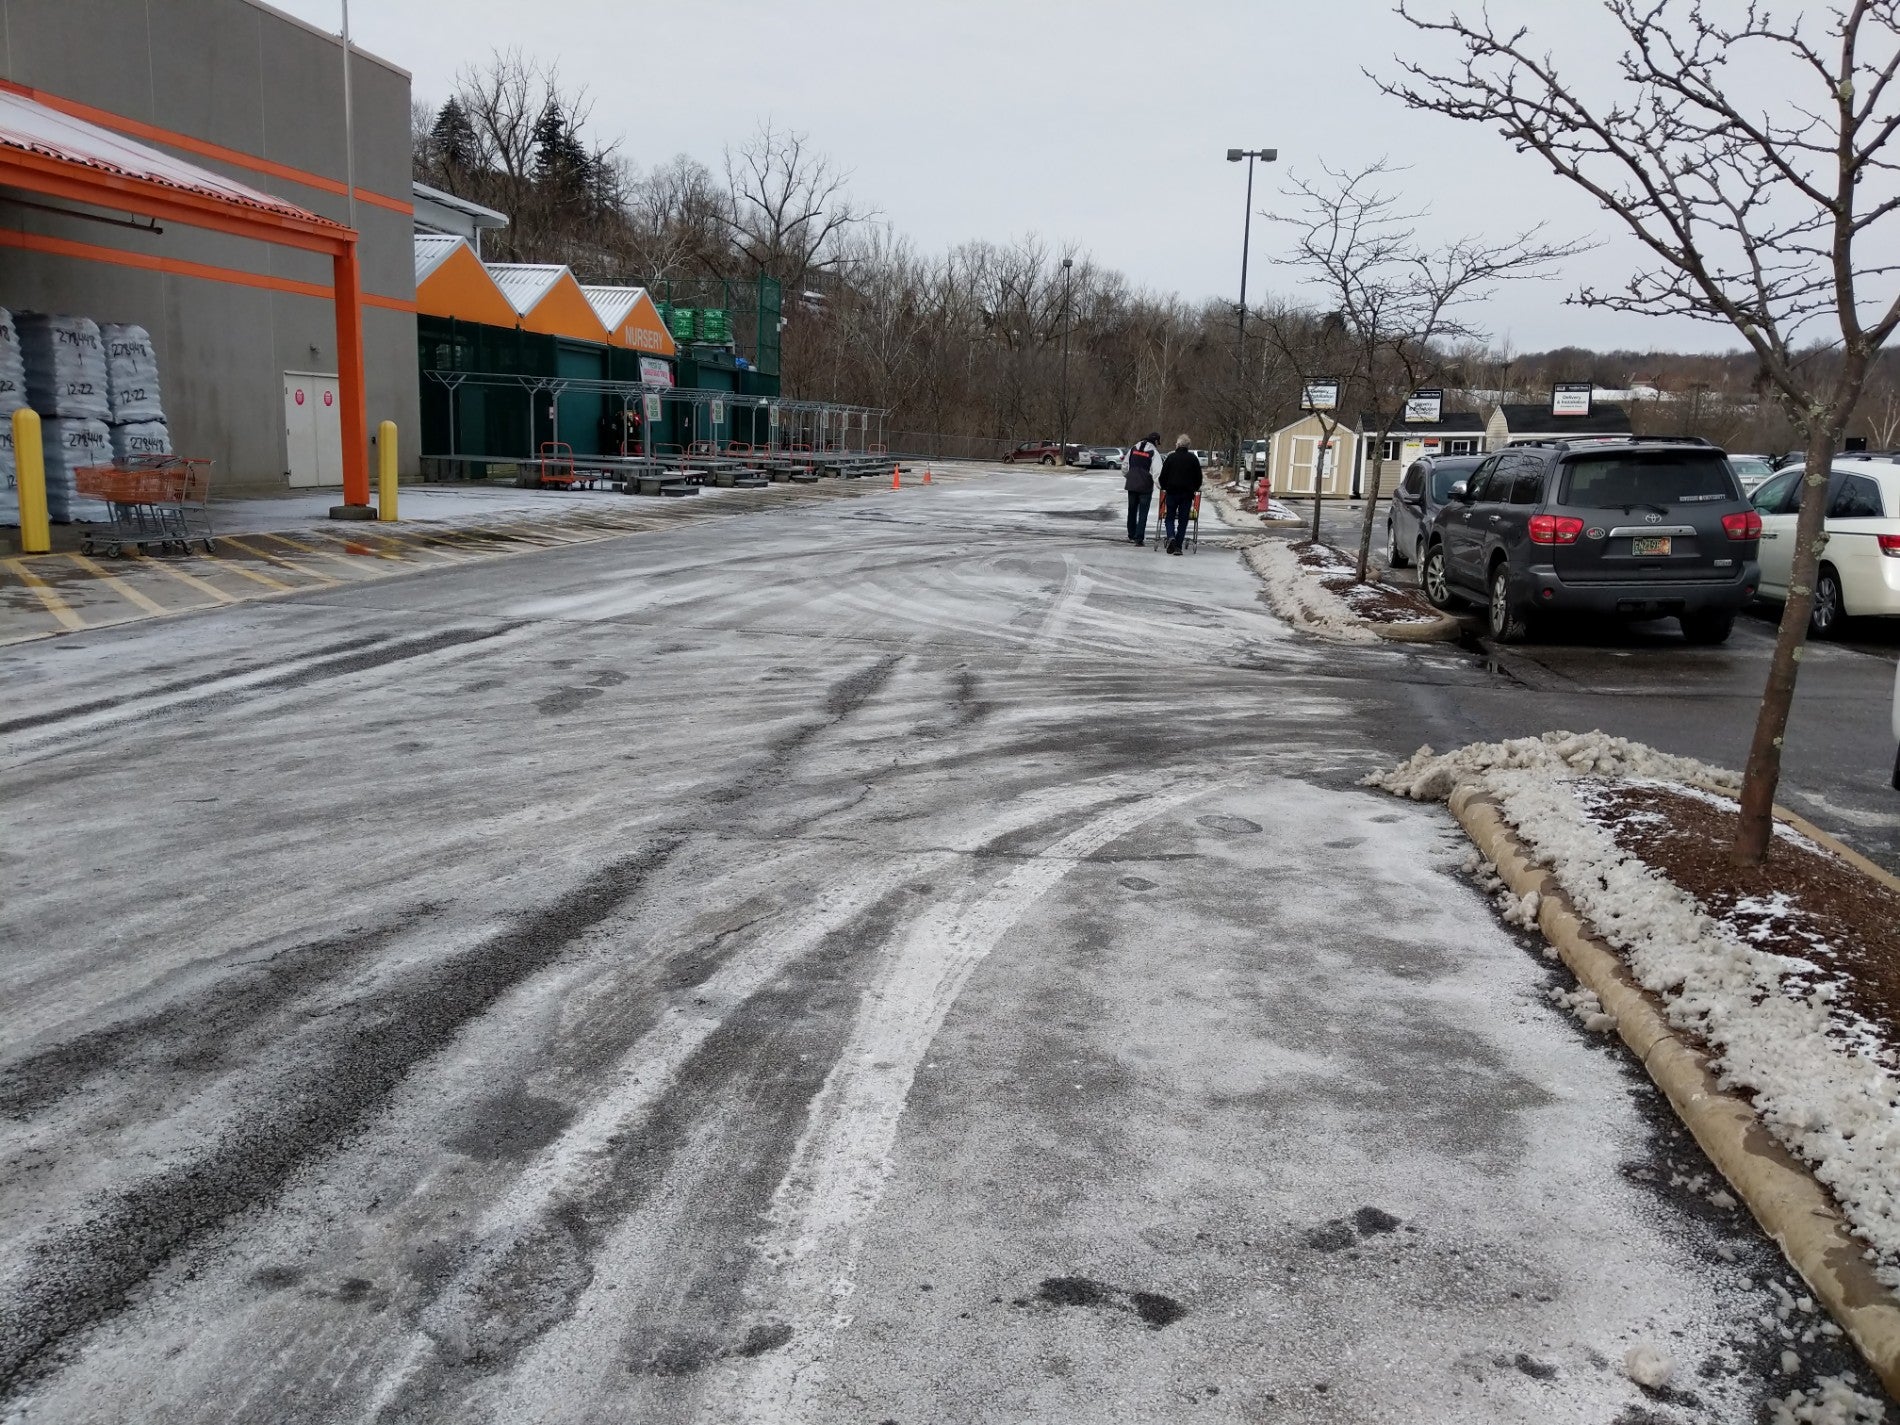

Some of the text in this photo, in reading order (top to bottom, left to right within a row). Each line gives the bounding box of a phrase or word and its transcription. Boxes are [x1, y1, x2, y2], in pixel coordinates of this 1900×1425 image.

[625, 324, 664, 350] NURSERY
[111, 341, 147, 358] 278448
[68, 433, 105, 449] 278448
[130, 436, 164, 453] 278448
